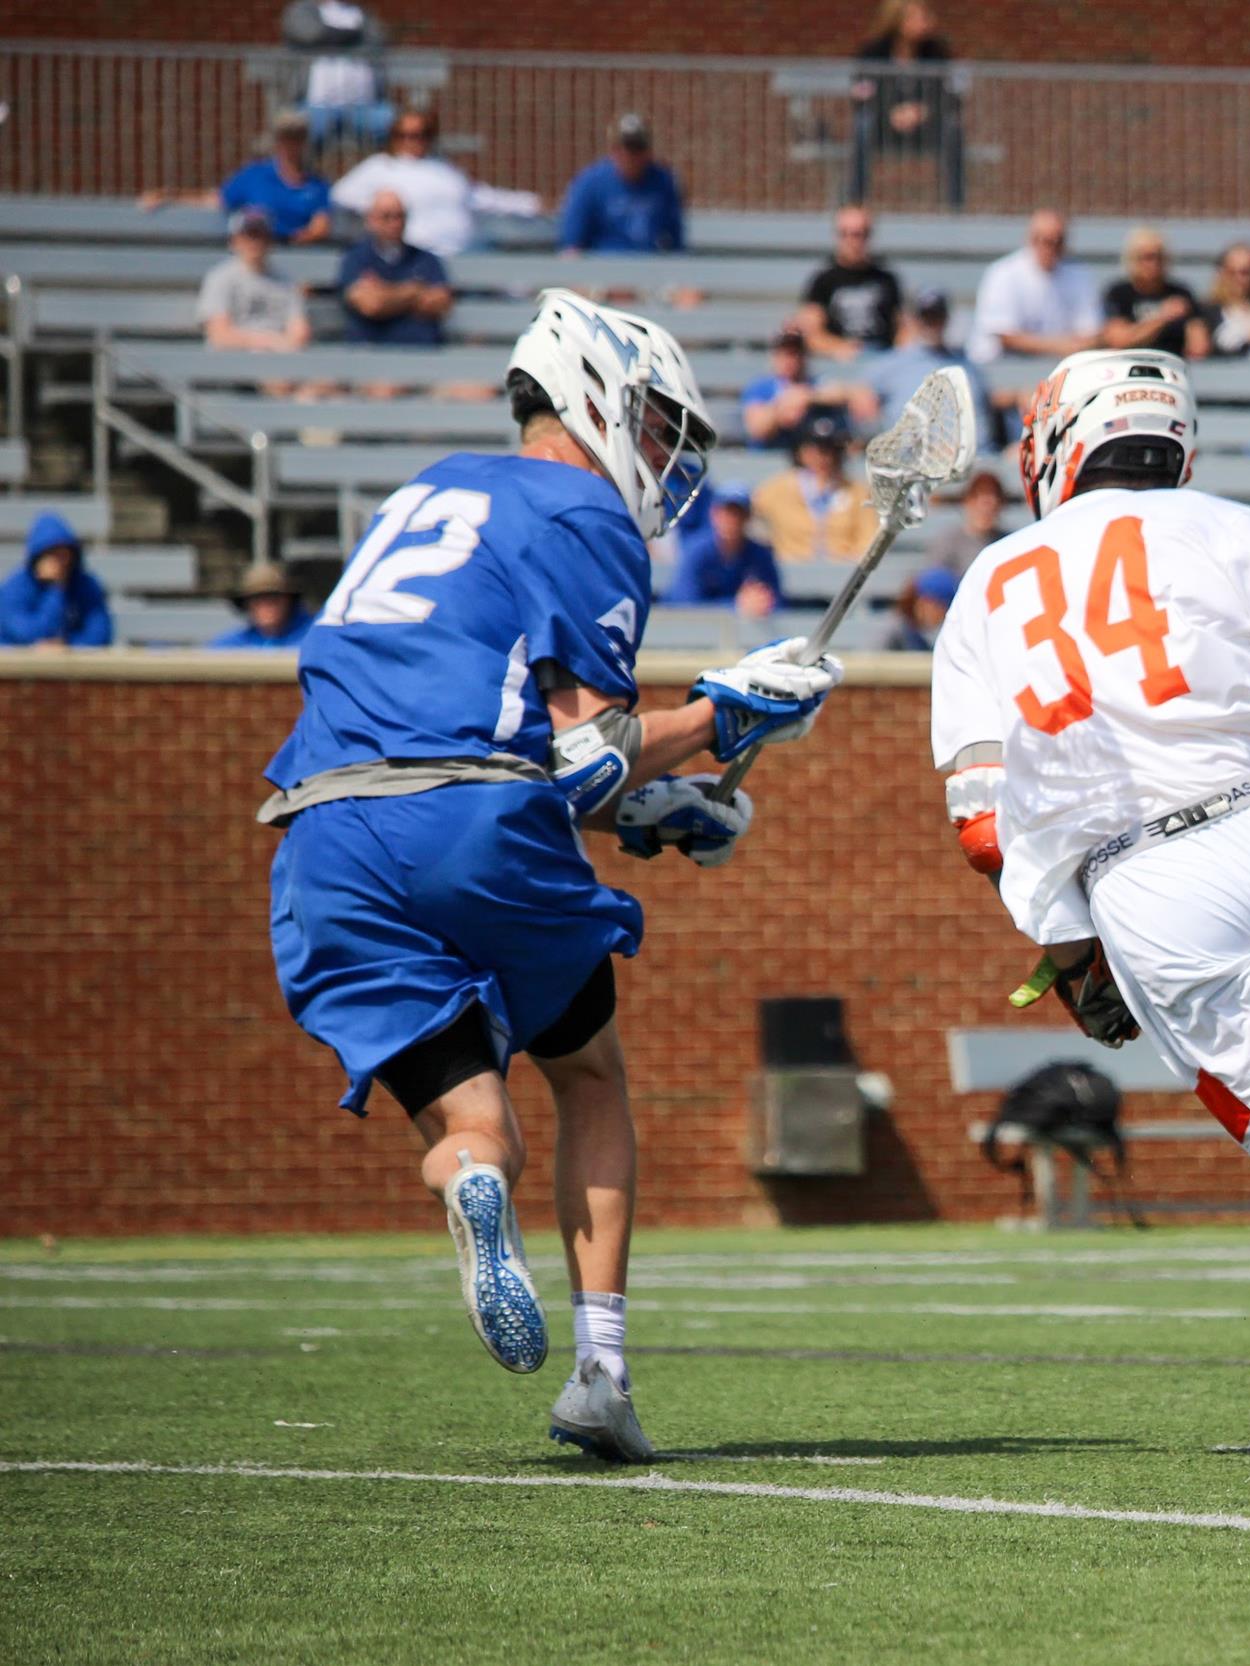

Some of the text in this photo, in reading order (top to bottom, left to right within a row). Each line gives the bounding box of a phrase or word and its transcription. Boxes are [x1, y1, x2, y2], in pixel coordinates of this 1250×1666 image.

[1113, 389, 1177, 407] MERCER
[314, 483, 492, 626] 12
[986, 515, 1192, 736] 34
